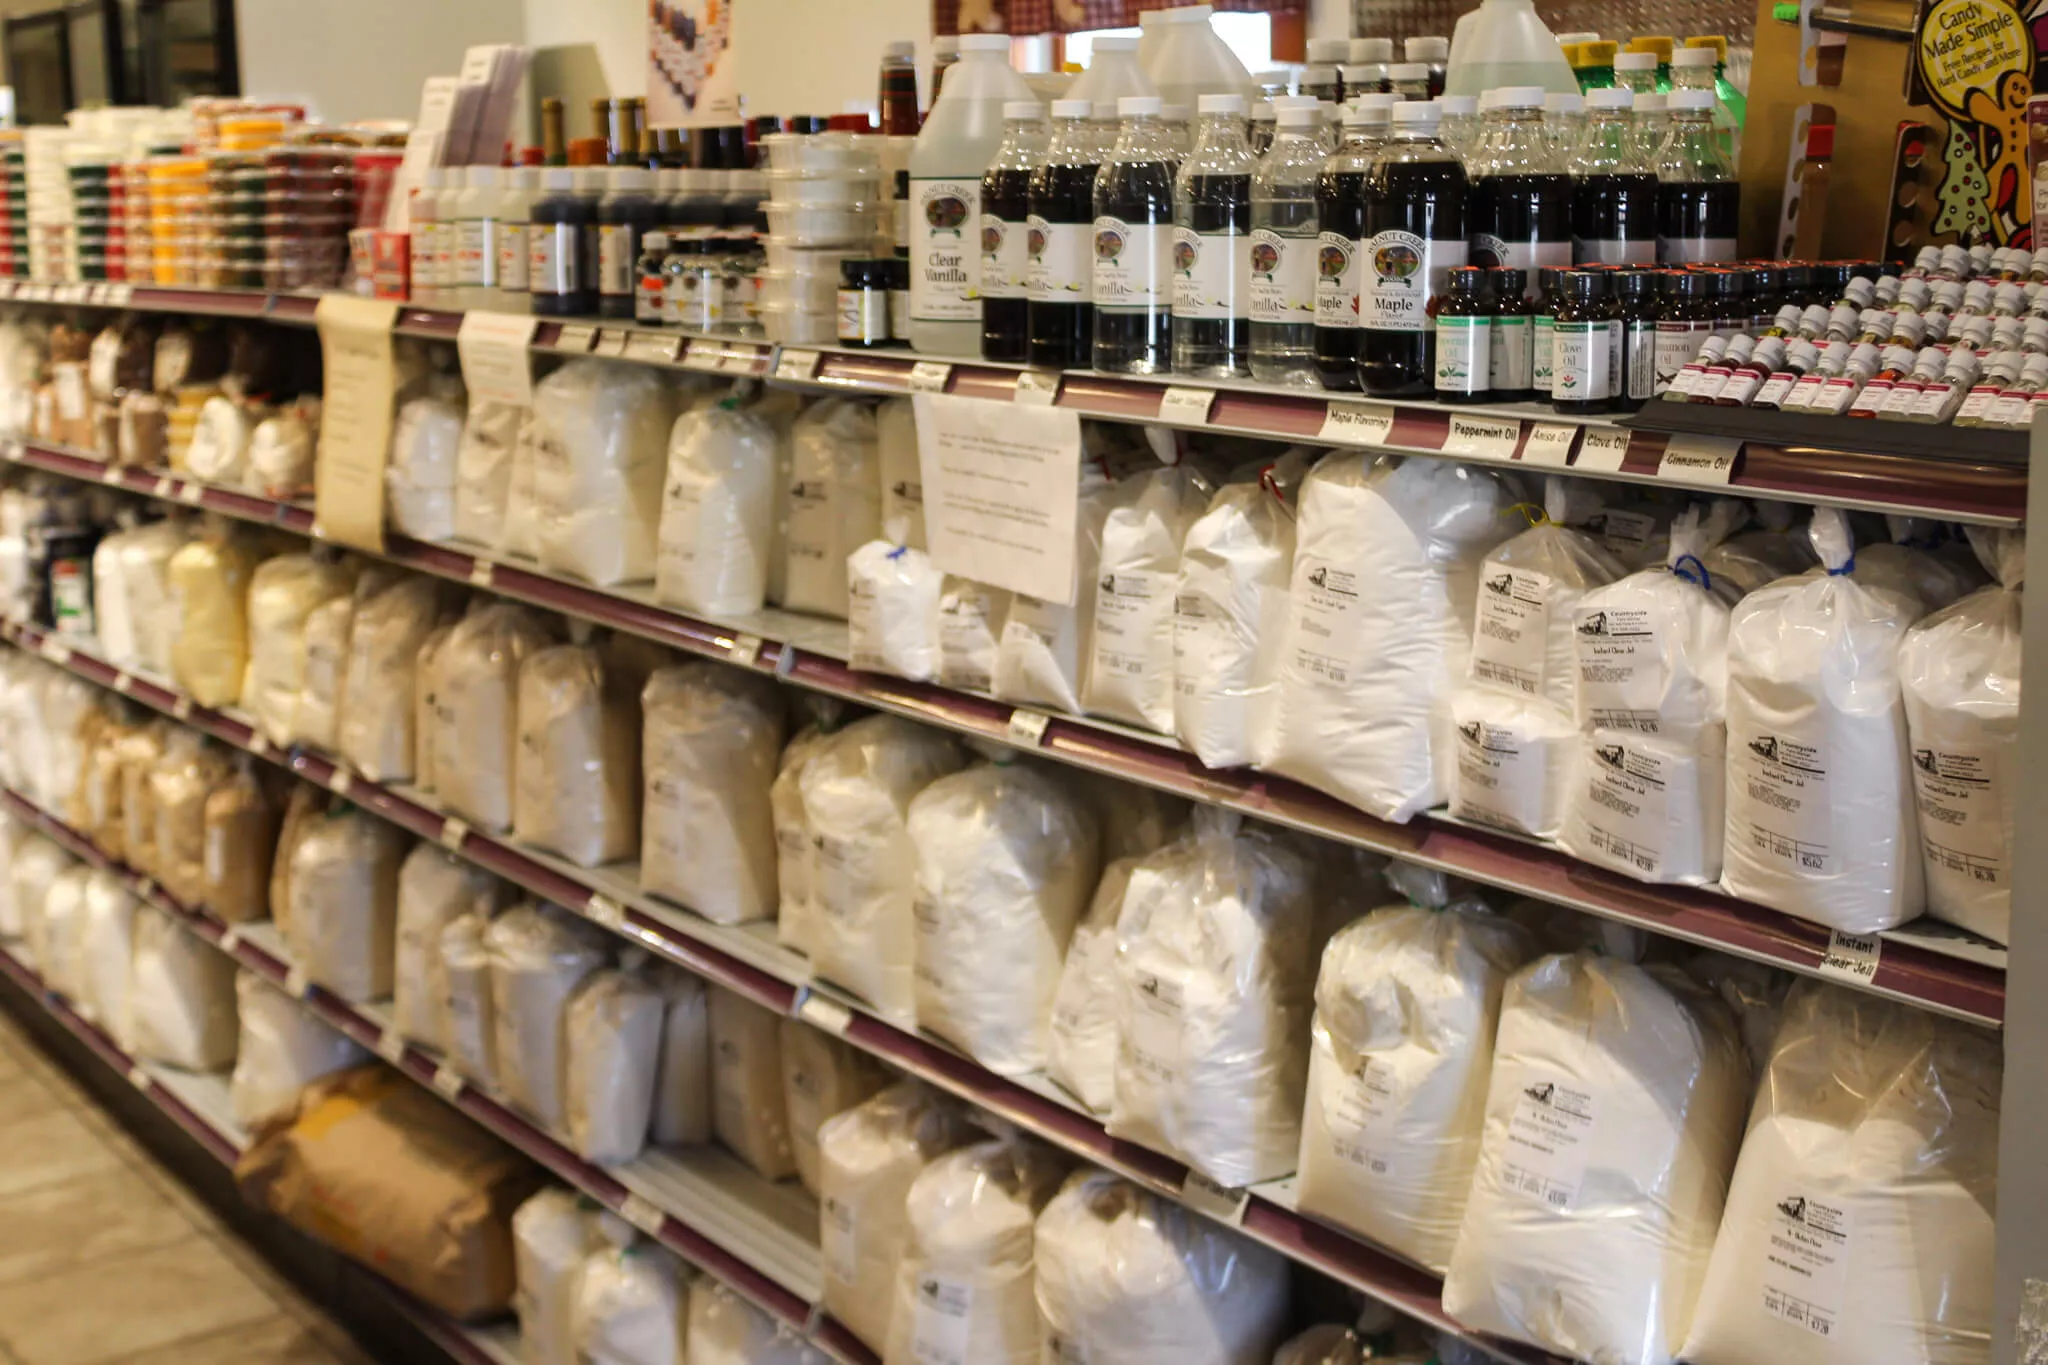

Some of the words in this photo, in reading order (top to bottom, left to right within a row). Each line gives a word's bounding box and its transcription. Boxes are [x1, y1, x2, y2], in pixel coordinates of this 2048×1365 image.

[1939, 2, 1982, 30] Candy
[1924, 33, 1964, 60] Made
[1965, 11, 2013, 42] Simple
[1943, 60, 1961, 72] Free
[1961, 48, 1993, 64] Recipes
[1936, 73, 1957, 89] Hard
[1957, 64, 1982, 80] Candy
[1984, 58, 1999, 70] and
[928, 252, 962, 266] Clear
[925, 268, 967, 282] Vanilla
[1375, 298, 1413, 313] Maple
[1559, 343, 1582, 353] Clove
[1563, 355, 1576, 366] Oil
[1330, 410, 1353, 424] Maple
[1354, 412, 1389, 430] Flavoring
[1454, 422, 1502, 439] Peppermint
[1504, 427, 1516, 441] Oil
[1533, 430, 1554, 442] Anise
[1556, 431, 1571, 444] Oil
[1587, 433, 1611, 449] Clove
[1613, 436, 1628, 450] Oil
[1666, 453, 1711, 469] Cinnamon
[1714, 456, 1730, 471] Oil
[1780, 740, 1817, 753] Countryside
[1836, 931, 1875, 953] Instant
[1821, 954, 1853, 970] Clear
[1854, 961, 1875, 976] Jell
